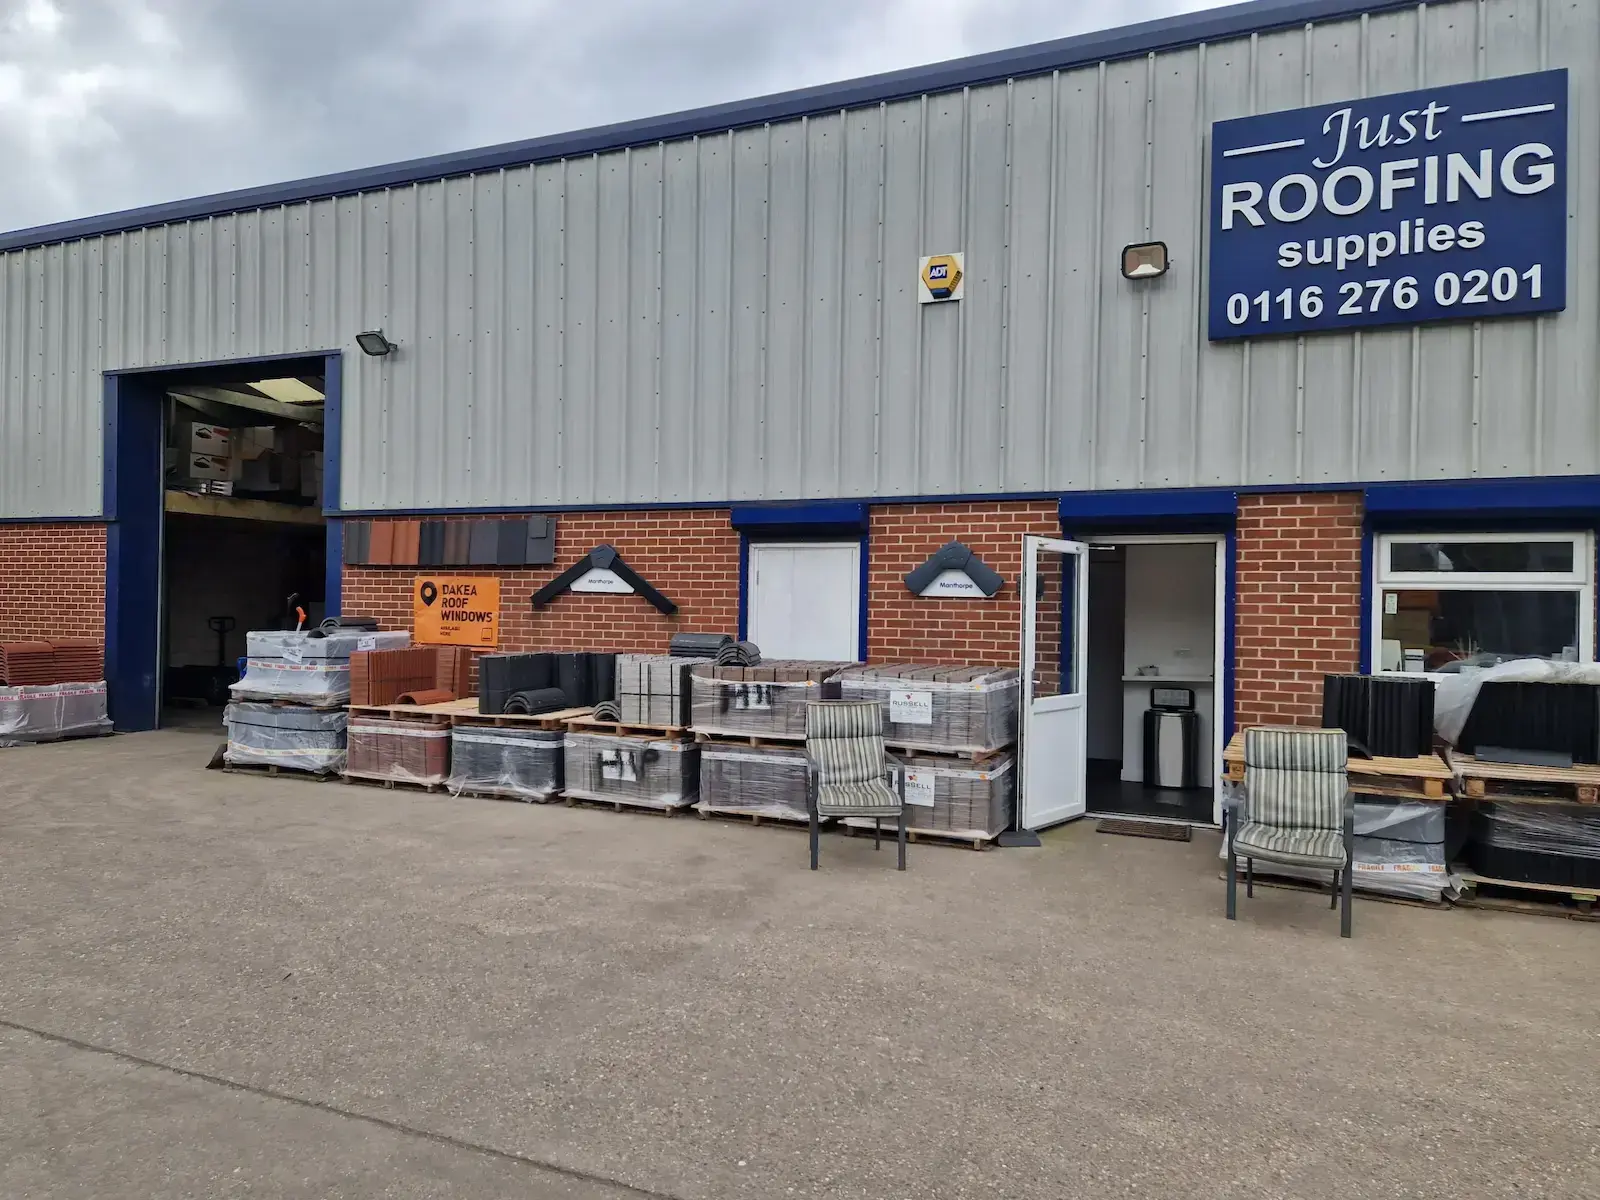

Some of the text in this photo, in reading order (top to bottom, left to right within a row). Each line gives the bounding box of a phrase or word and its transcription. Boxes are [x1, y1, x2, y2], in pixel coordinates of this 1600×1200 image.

[1312, 101, 1450, 169] Just
[1221, 142, 1556, 230] ROOFING
[1277, 218, 1486, 270] supplies
[930, 266, 947, 278] ADT
[1226, 264, 1543, 325] 0116 276 0201
[442, 584, 478, 596] DAKEA
[940, 582, 974, 590] Manthorpe
[441, 597, 469, 609] ROOF
[440, 610, 493, 623] WINDOWS
[892, 700, 929, 708] RUSSELL
[894, 780, 932, 790] RSSELL
